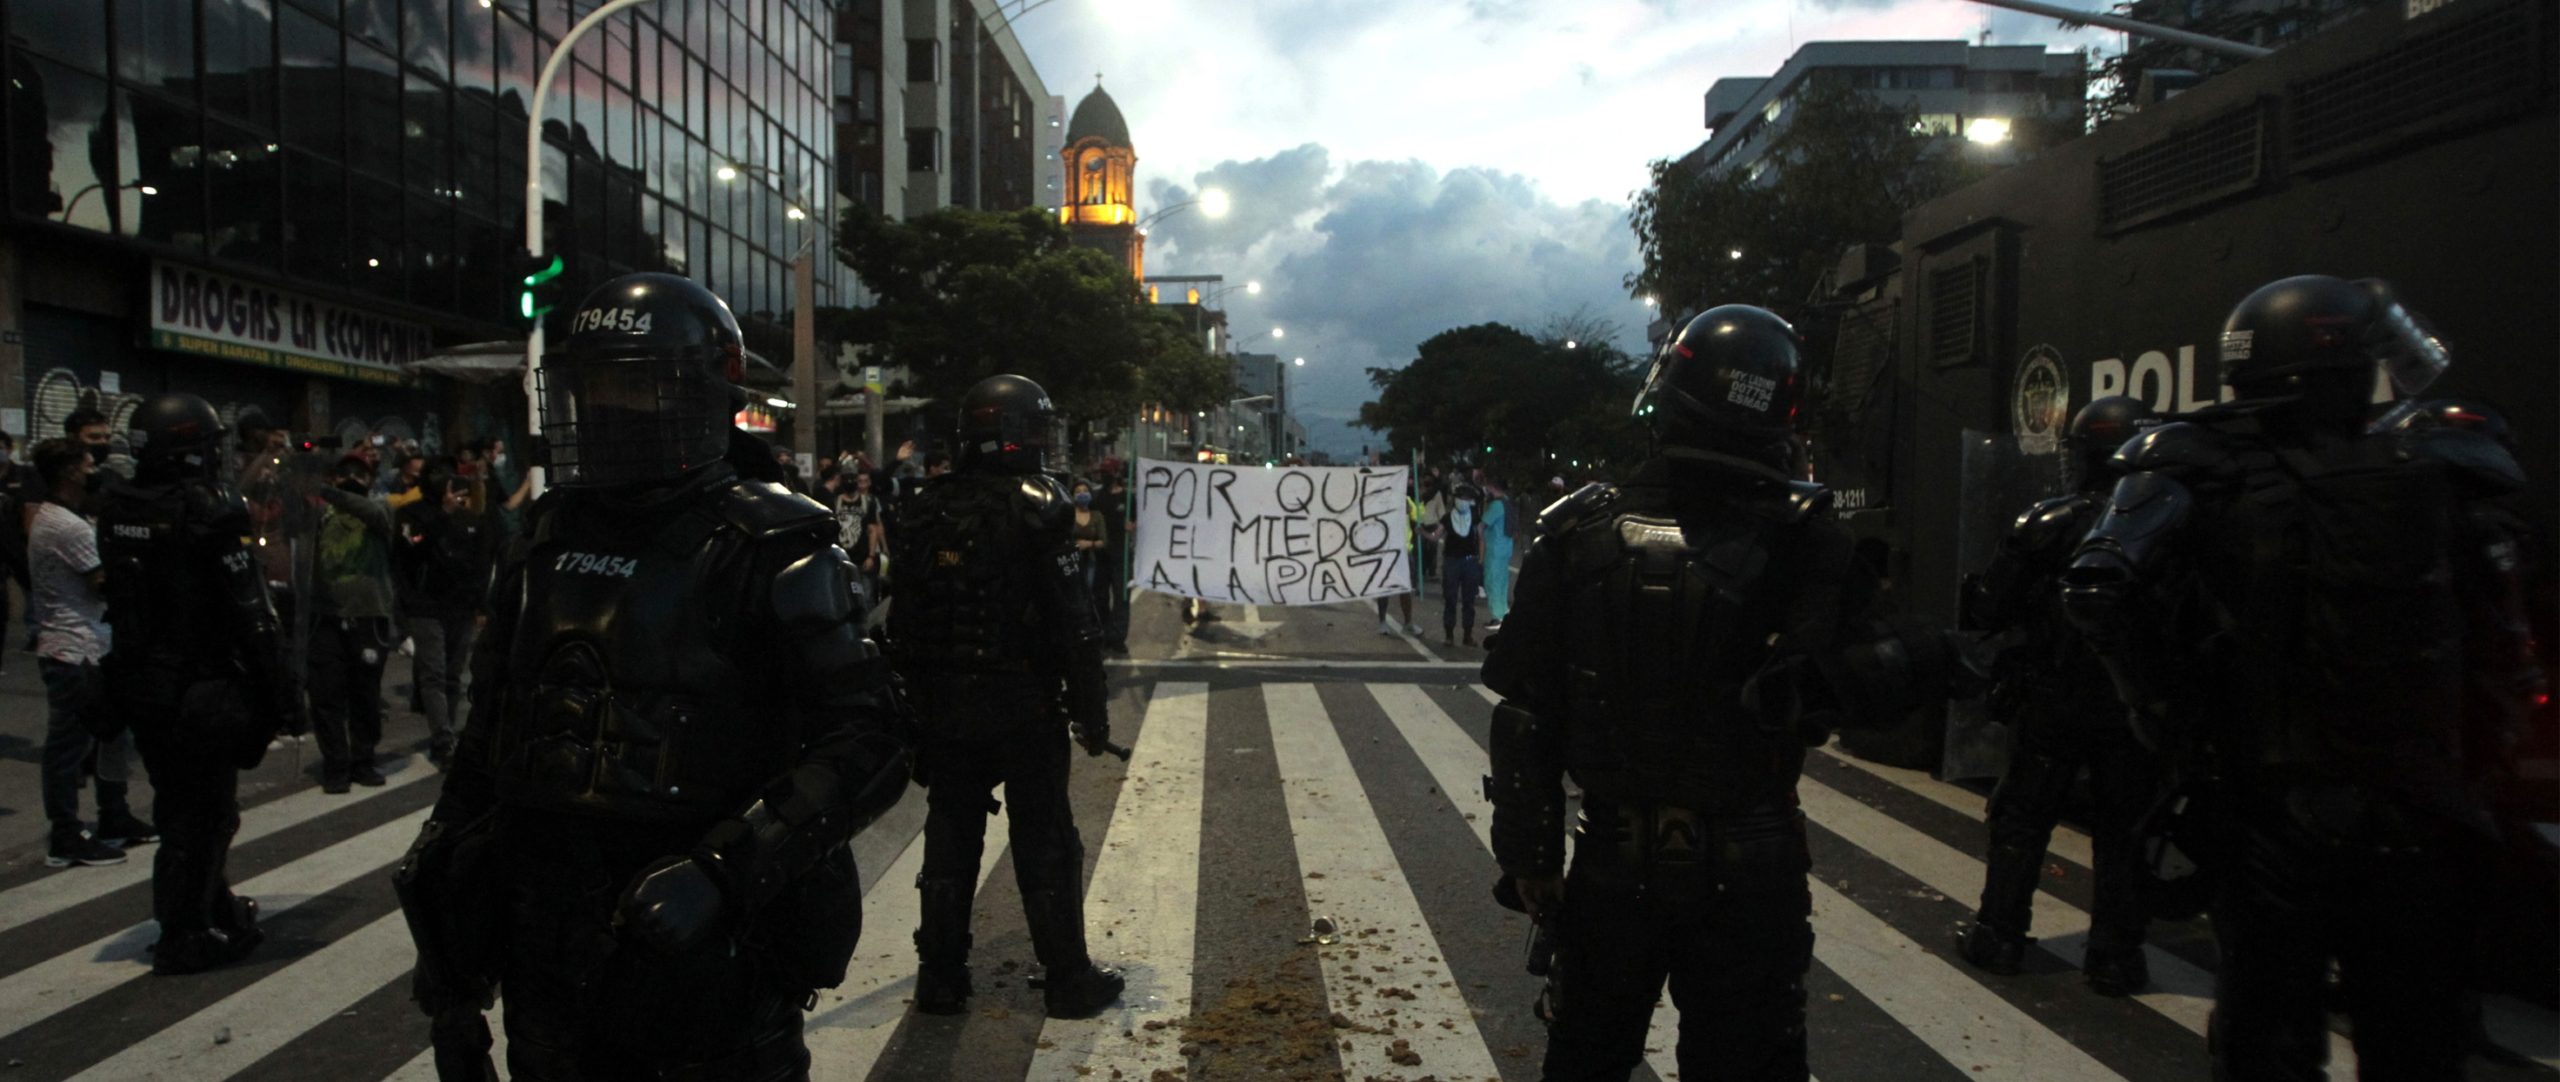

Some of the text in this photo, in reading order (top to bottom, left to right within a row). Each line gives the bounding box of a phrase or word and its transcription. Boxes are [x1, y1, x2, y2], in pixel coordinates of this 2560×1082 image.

[160, 265, 281, 344] DROGAS
[290, 299, 317, 351] LA
[571, 307, 653, 336] 179454
[1727, 390, 1769, 413] ESMAD
[1143, 466, 1405, 522] POR QUE
[554, 549, 639, 578] 179454
[1169, 514, 1390, 565] EL MIEDO
[1149, 559, 1186, 595] A
[1263, 549, 1403, 605] PAZ
